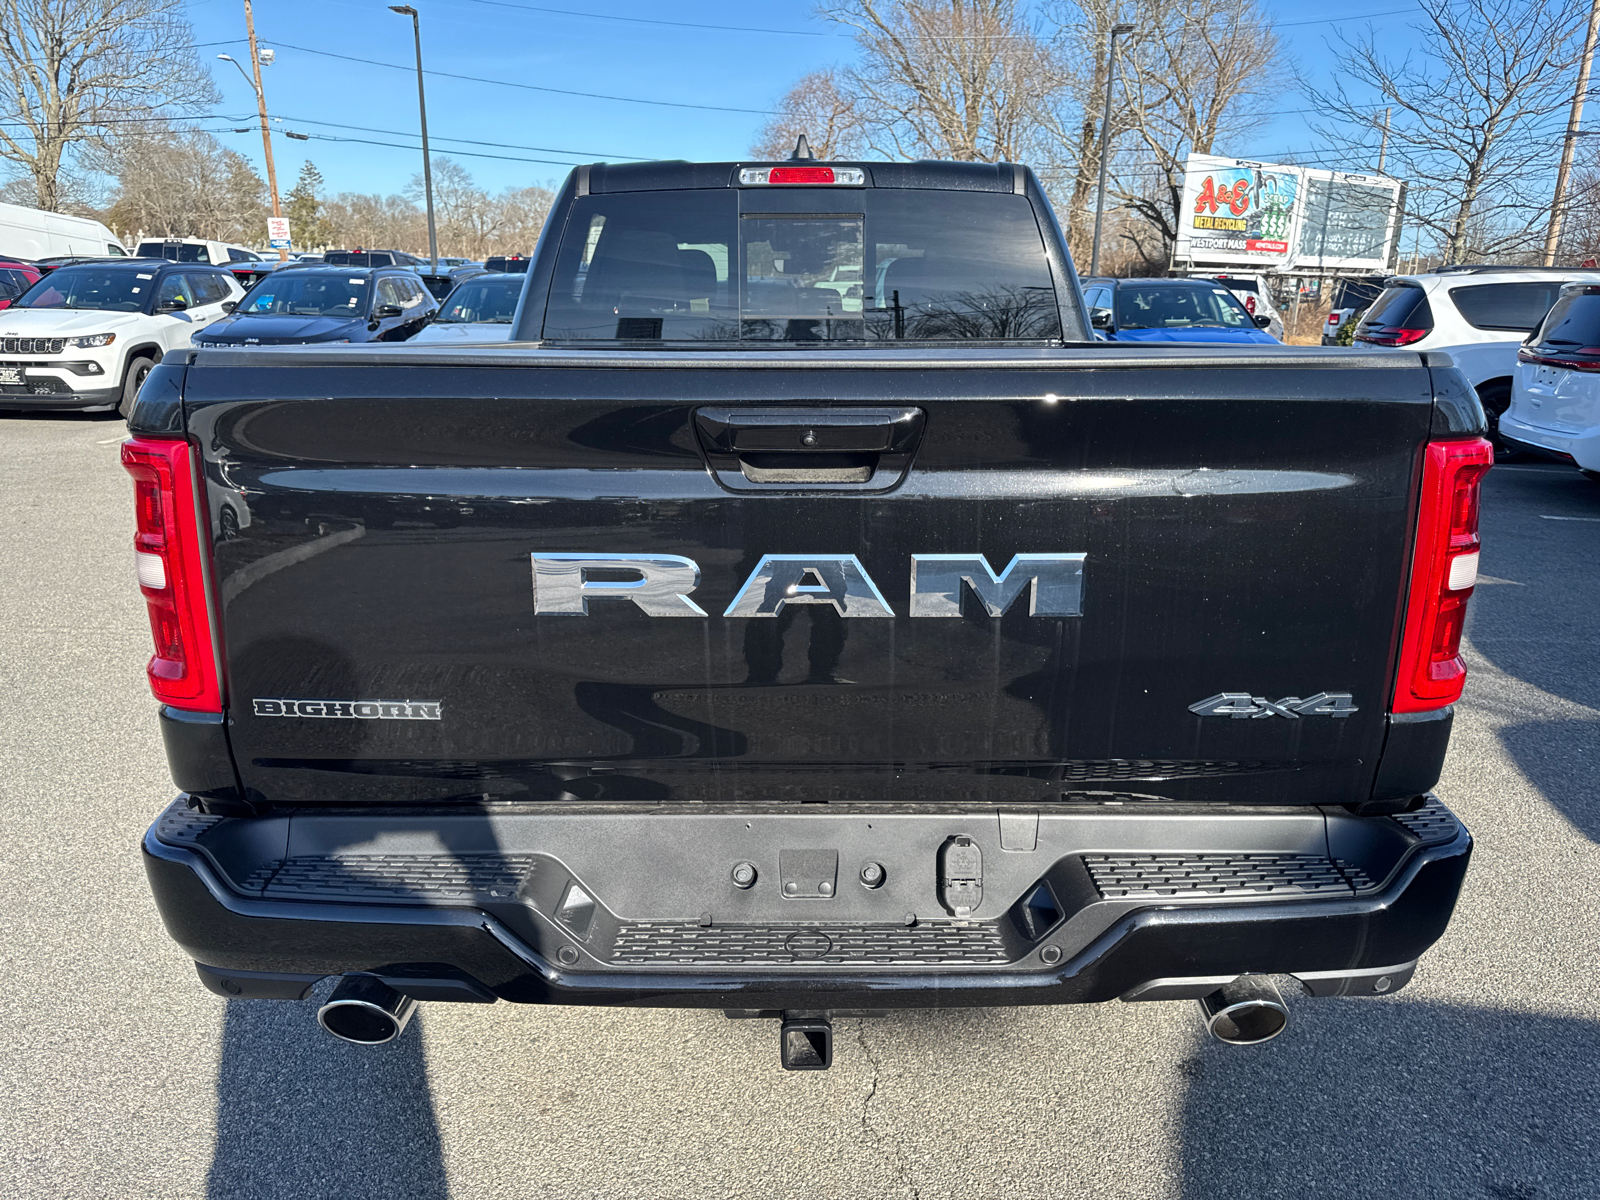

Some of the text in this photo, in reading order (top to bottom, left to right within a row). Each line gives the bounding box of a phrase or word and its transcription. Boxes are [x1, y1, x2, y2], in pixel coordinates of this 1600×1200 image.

[1194, 176, 1249, 216] A&E
[1264, 193, 1289, 205] SCRAP
[1194, 215, 1247, 231] METAL RECYCLING
[1260, 212, 1285, 237] $$$
[1190, 237, 1247, 250] WESTPORT MASS
[531, 552, 1087, 618] RAM
[253, 698, 443, 720] BIGHORN
